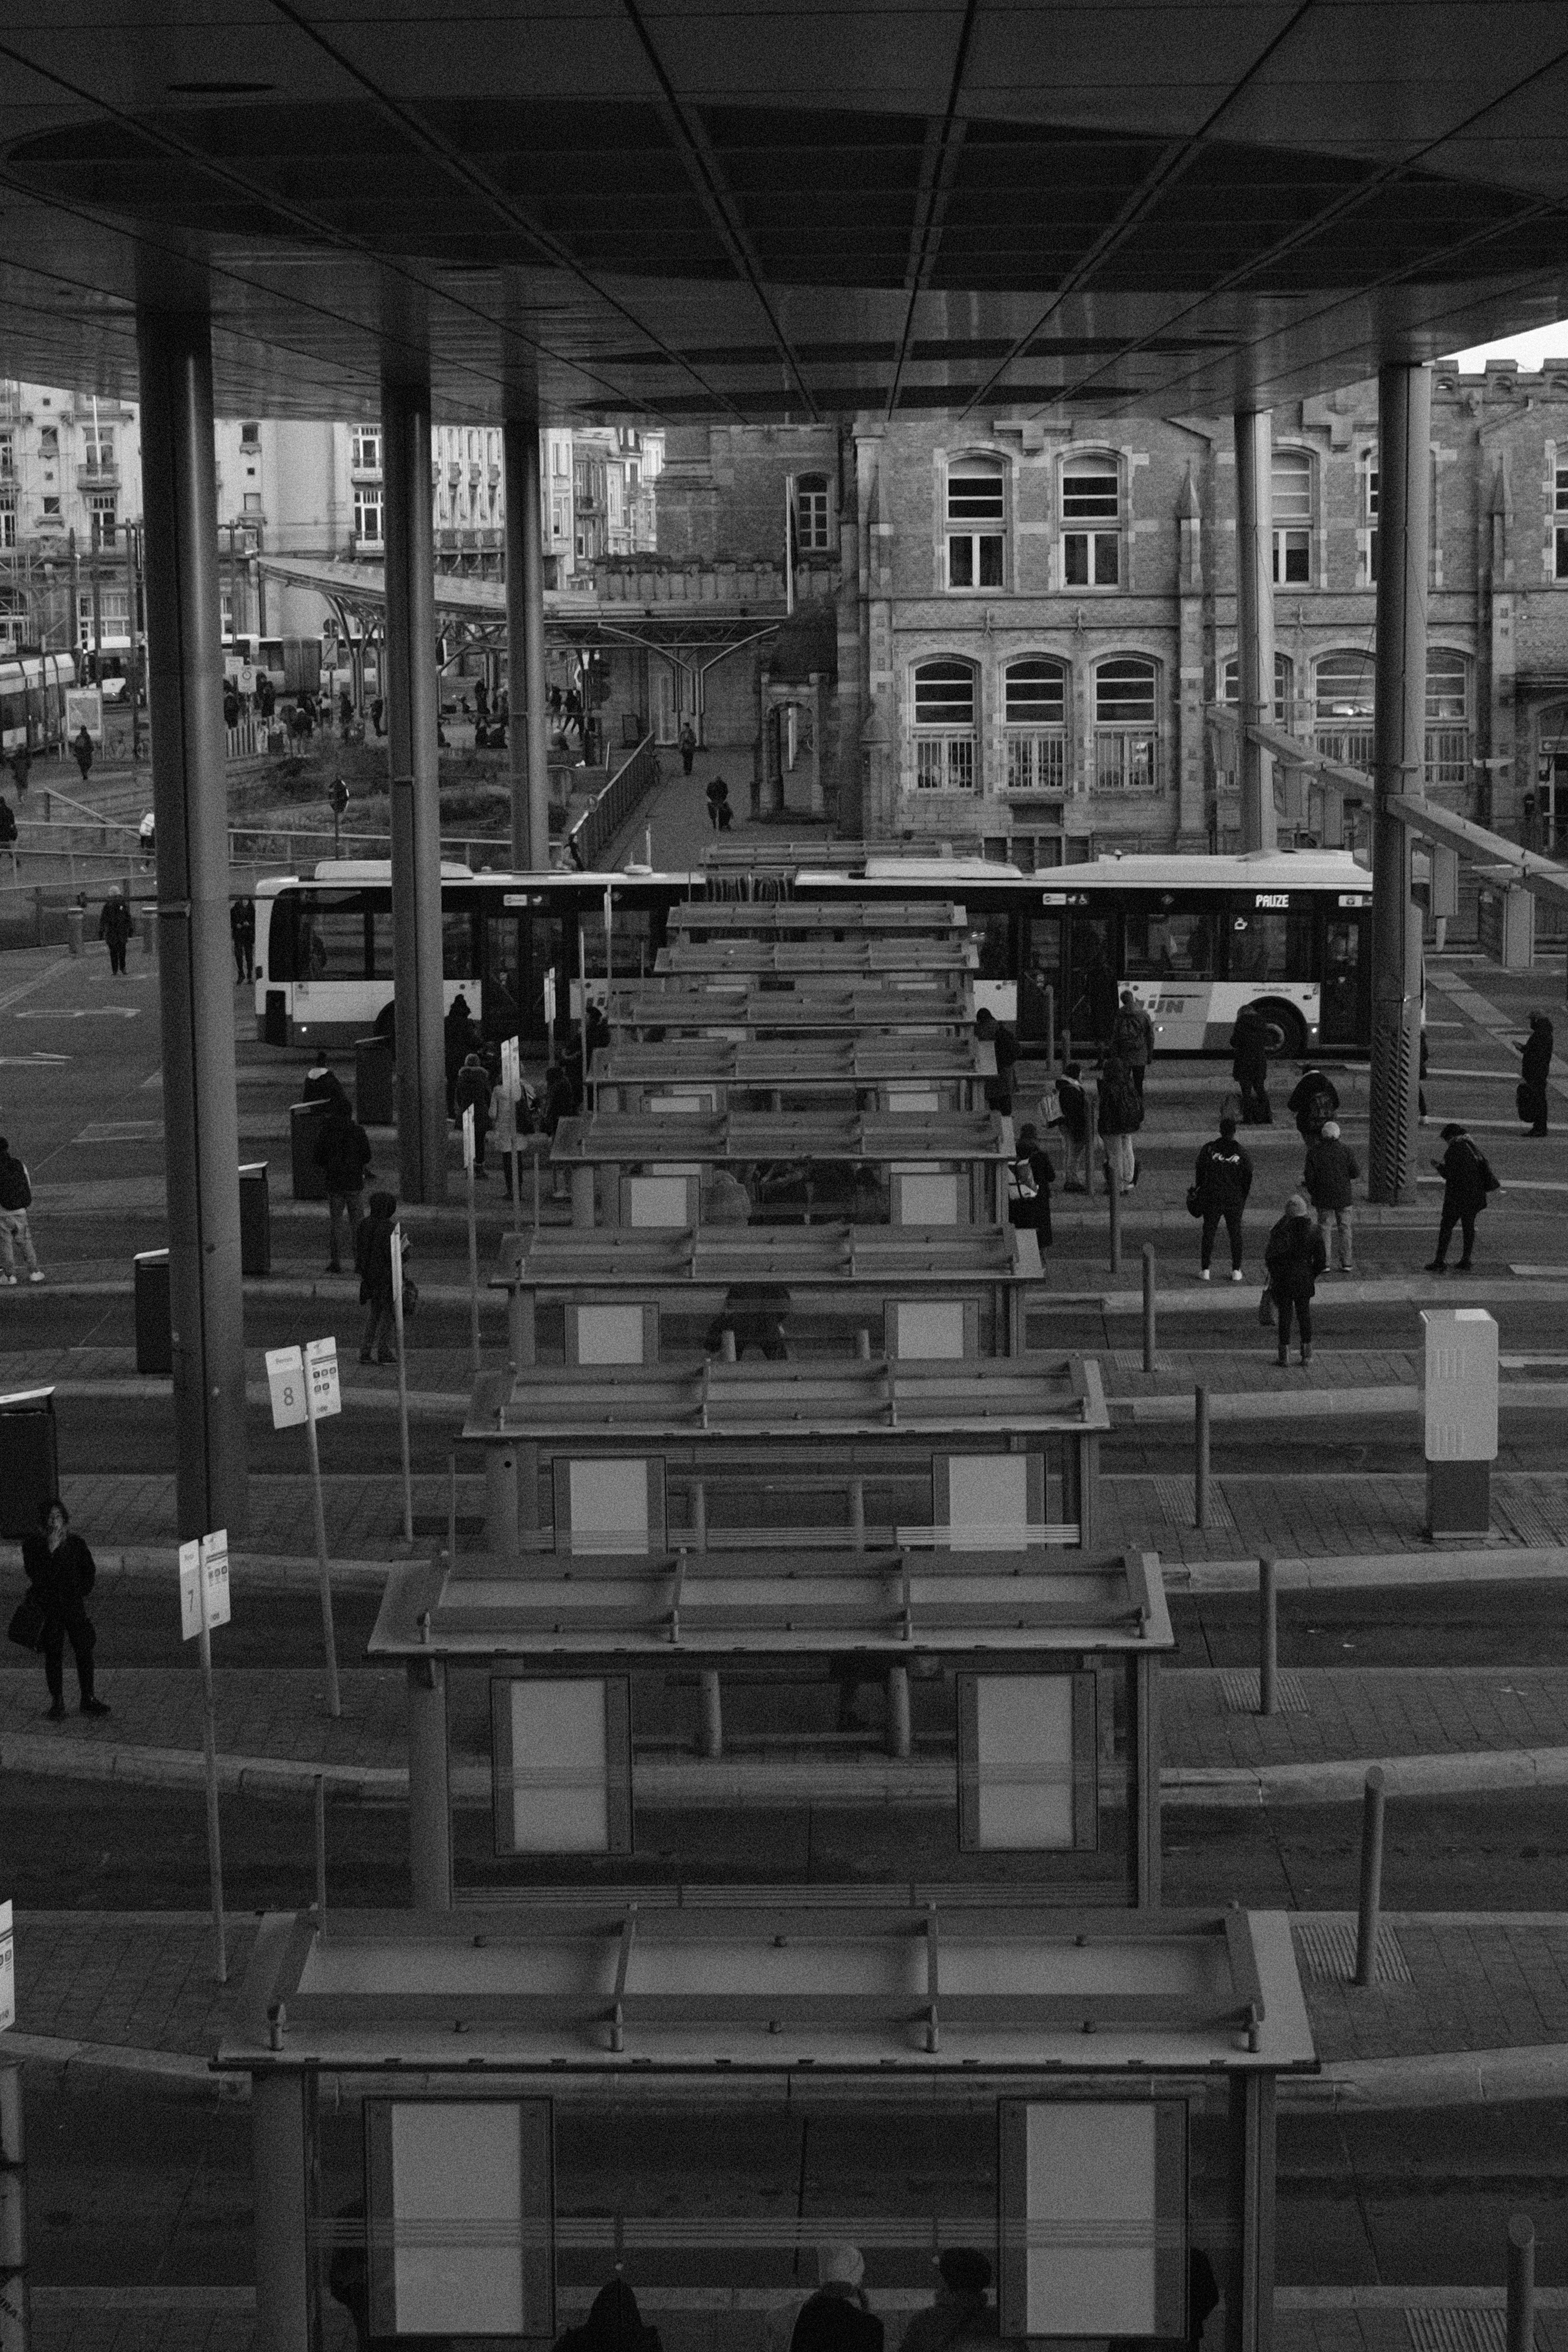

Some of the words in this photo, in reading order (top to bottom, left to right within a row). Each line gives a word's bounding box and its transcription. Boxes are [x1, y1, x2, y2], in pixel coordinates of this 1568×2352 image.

[1255, 894, 1289, 908] PAUZE
[284, 1387, 294, 1406] 8
[188, 1589, 194, 1612] 7
